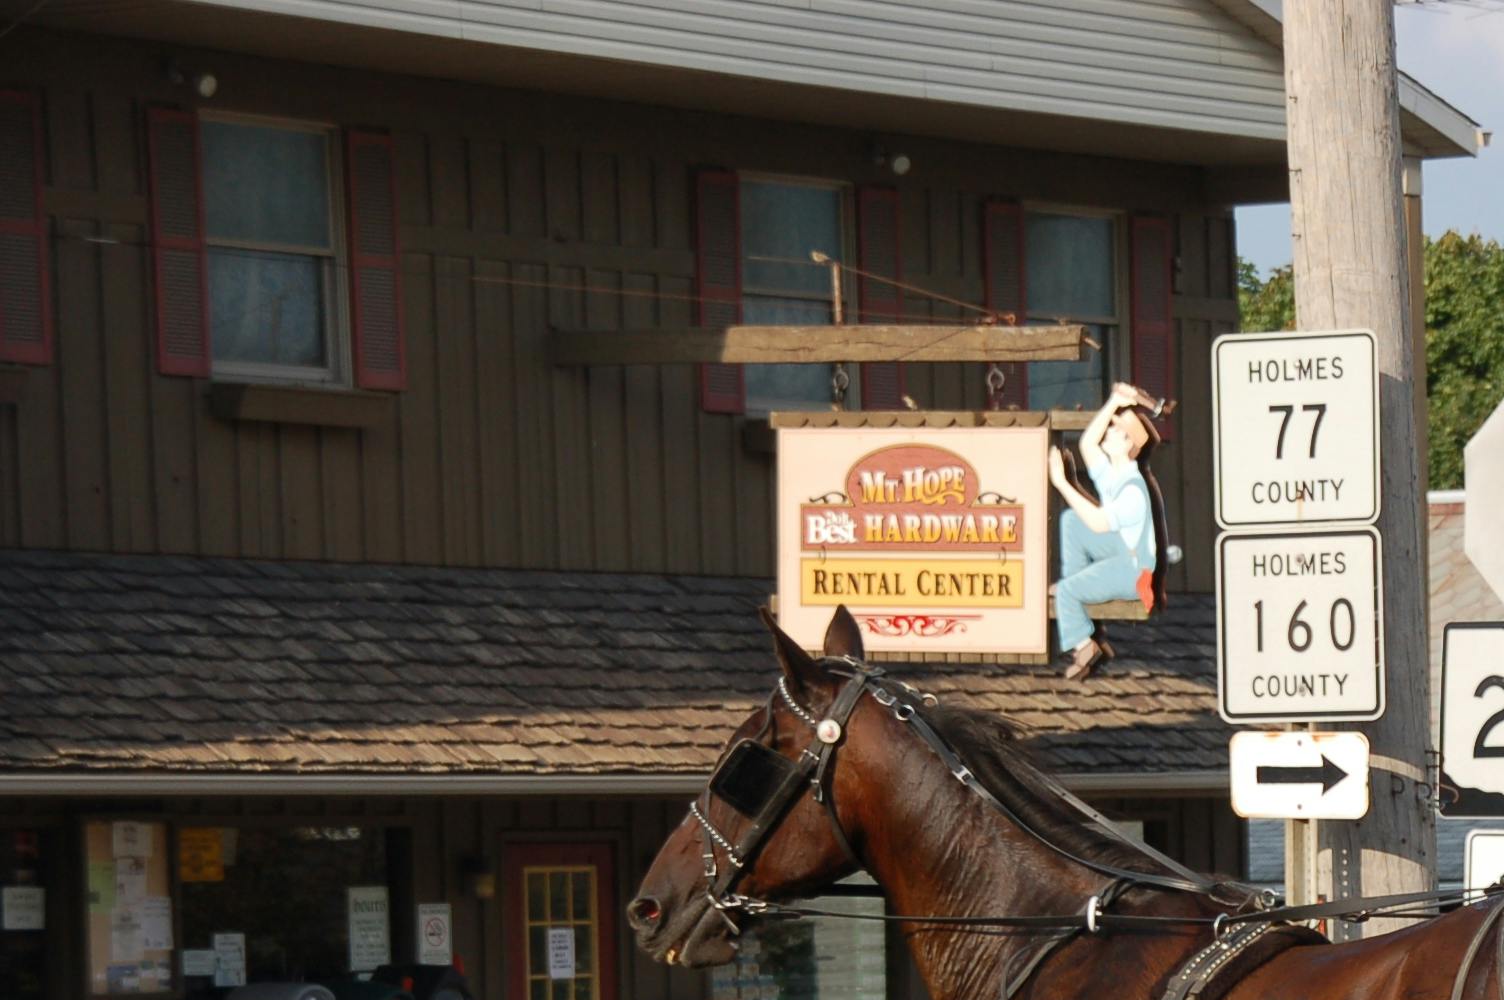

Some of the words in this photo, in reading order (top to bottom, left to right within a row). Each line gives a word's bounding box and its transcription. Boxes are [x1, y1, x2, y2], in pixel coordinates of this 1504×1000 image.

[1249, 356, 1344, 383] HOLMES
[1269, 404, 1326, 459] 77
[1252, 479, 1344, 504] COUNTY
[806, 514, 858, 543] Best
[864, 513, 1018, 543] HARDWARE
[1253, 552, 1346, 576] HOLMES
[813, 569, 906, 596] RENTAL
[917, 570, 1012, 597] CENTER
[1254, 597, 1355, 653] 160
[1252, 673, 1348, 697] COUNTY
